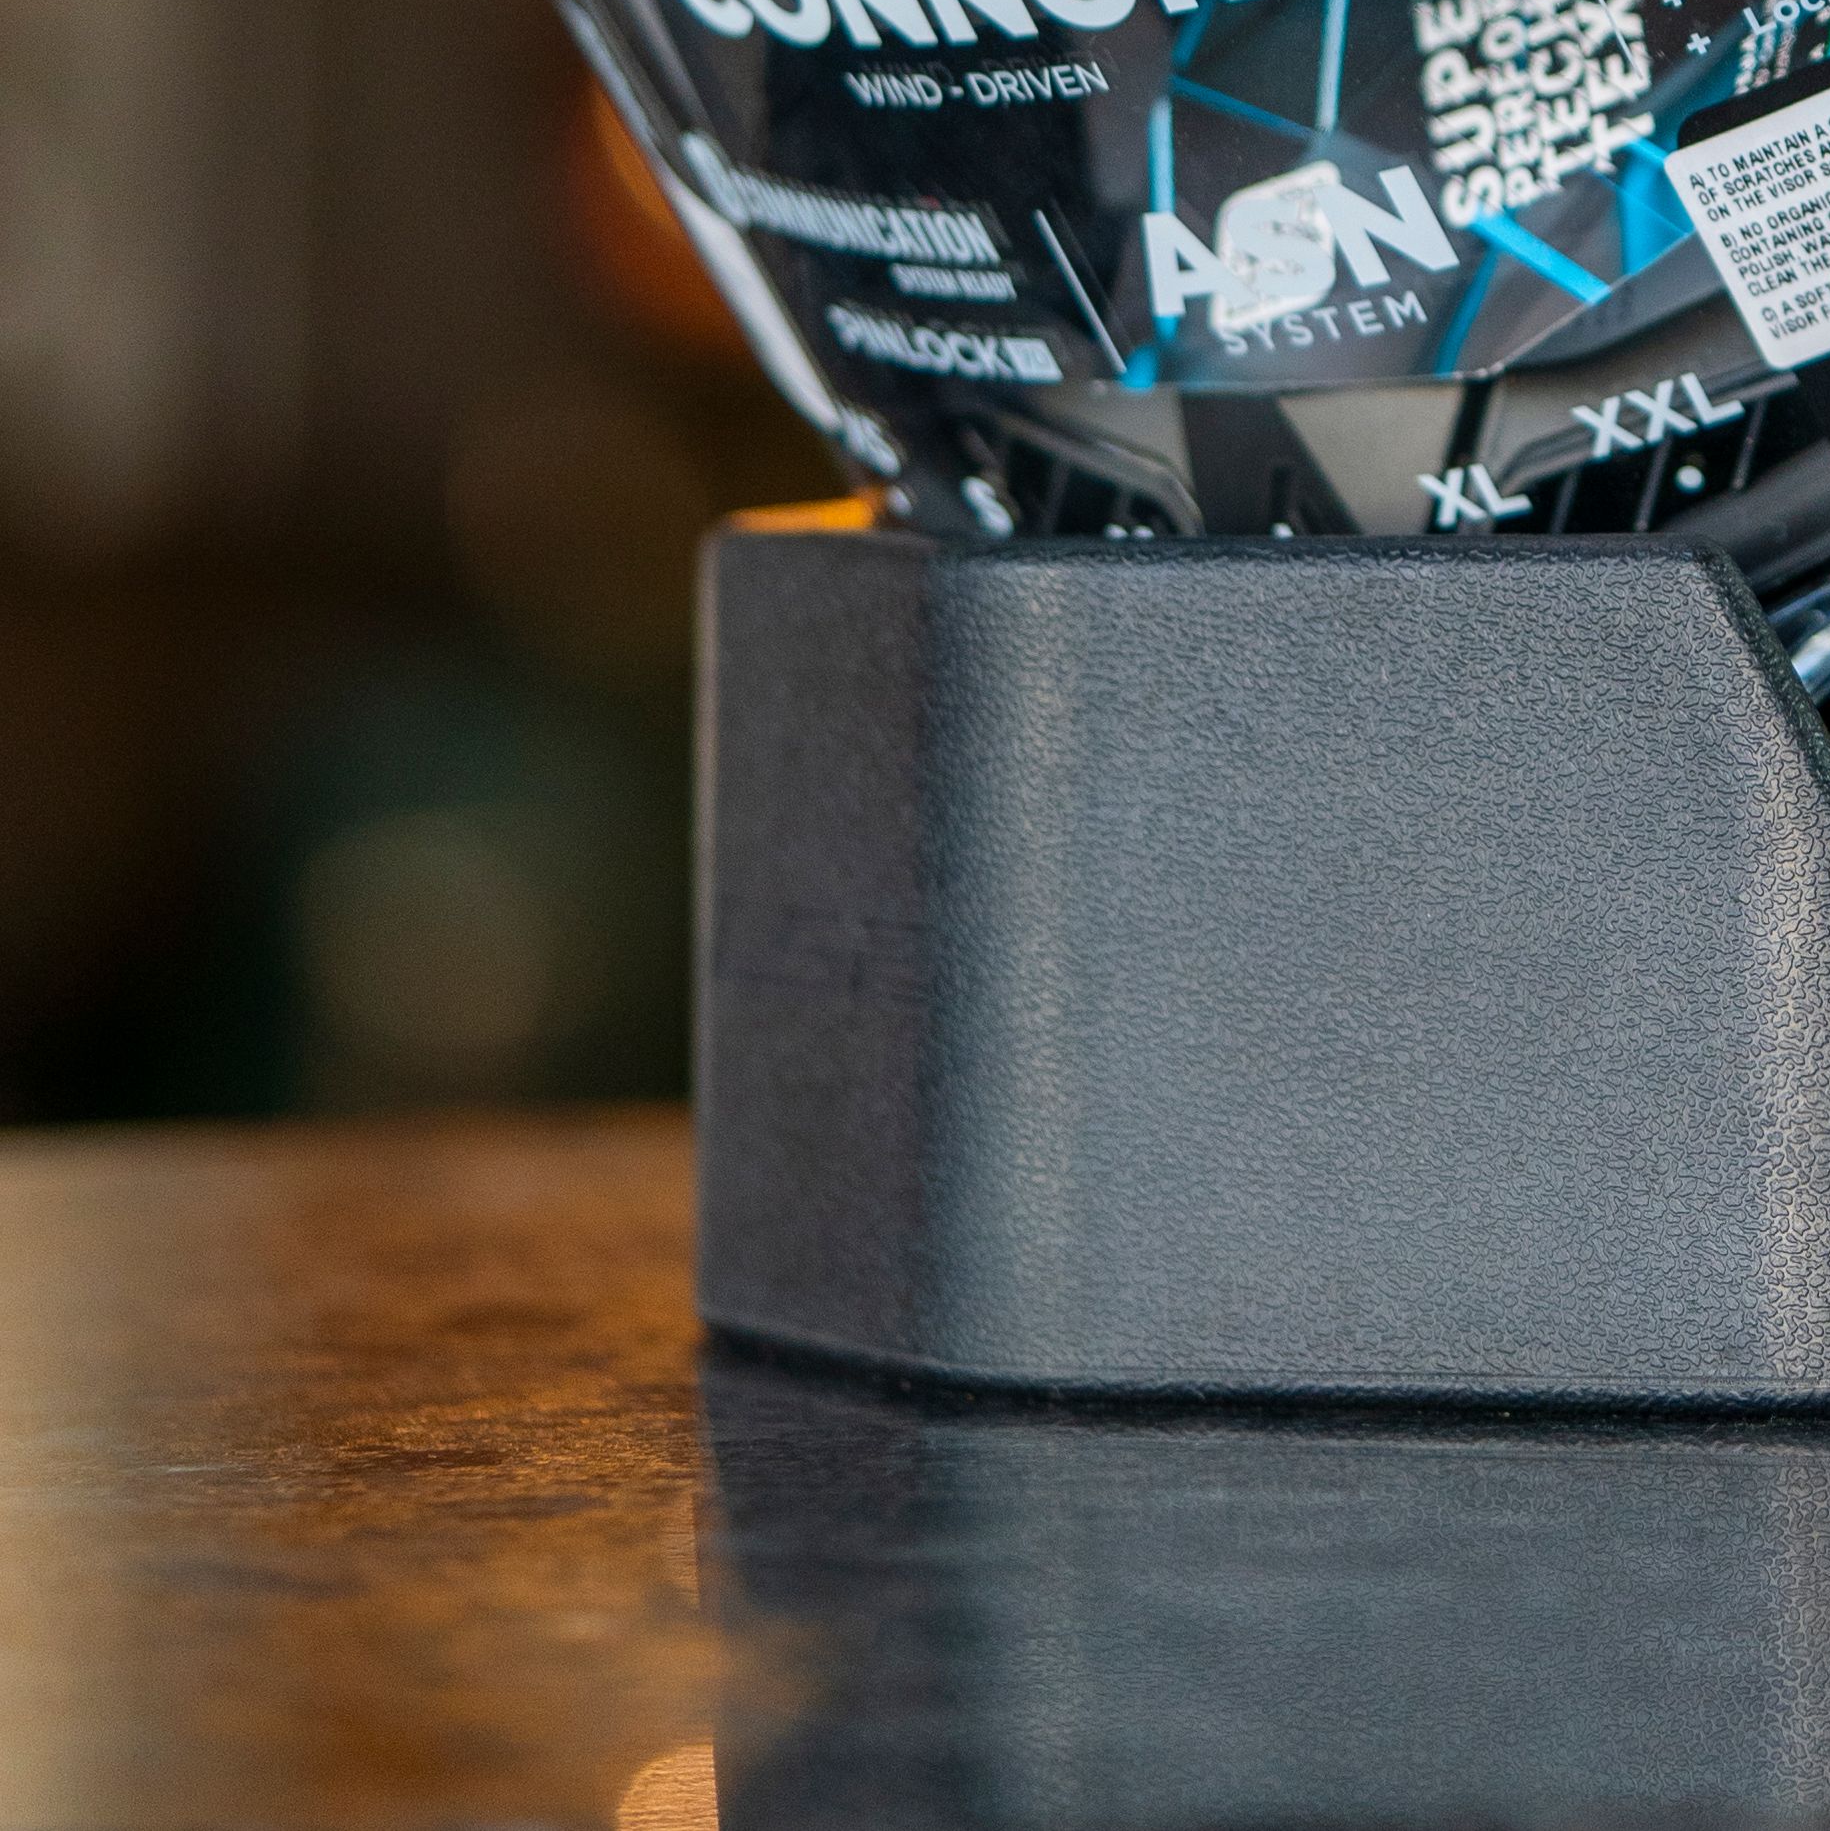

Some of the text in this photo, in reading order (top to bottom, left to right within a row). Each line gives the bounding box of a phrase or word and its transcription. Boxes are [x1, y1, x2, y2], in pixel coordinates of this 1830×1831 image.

[844, 72, 943, 109] WIND
[964, 61, 1110, 108] DRIVEN
[1698, 187, 1718, 206] OF
[1722, 148, 1817, 196] SCRATCHES
[1706, 162, 1730, 182] TO
[1732, 129, 1812, 173] MAINTAIN
[1814, 123, 1829, 140] A
[1706, 203, 1731, 222] ON
[1732, 189, 1766, 212] THE
[1766, 168, 1817, 199] VISOR
[1730, 216, 1825, 264] CONTAINING
[1739, 222, 1763, 241] NO
[1747, 267, 1798, 297] CLEAN
[1224, 290, 1428, 355] SYSTEM
[1769, 311, 1819, 339] VISOR
[1781, 300, 1794, 316] A
[1570, 372, 1746, 460] XXL
[1417, 463, 1533, 529] XL
